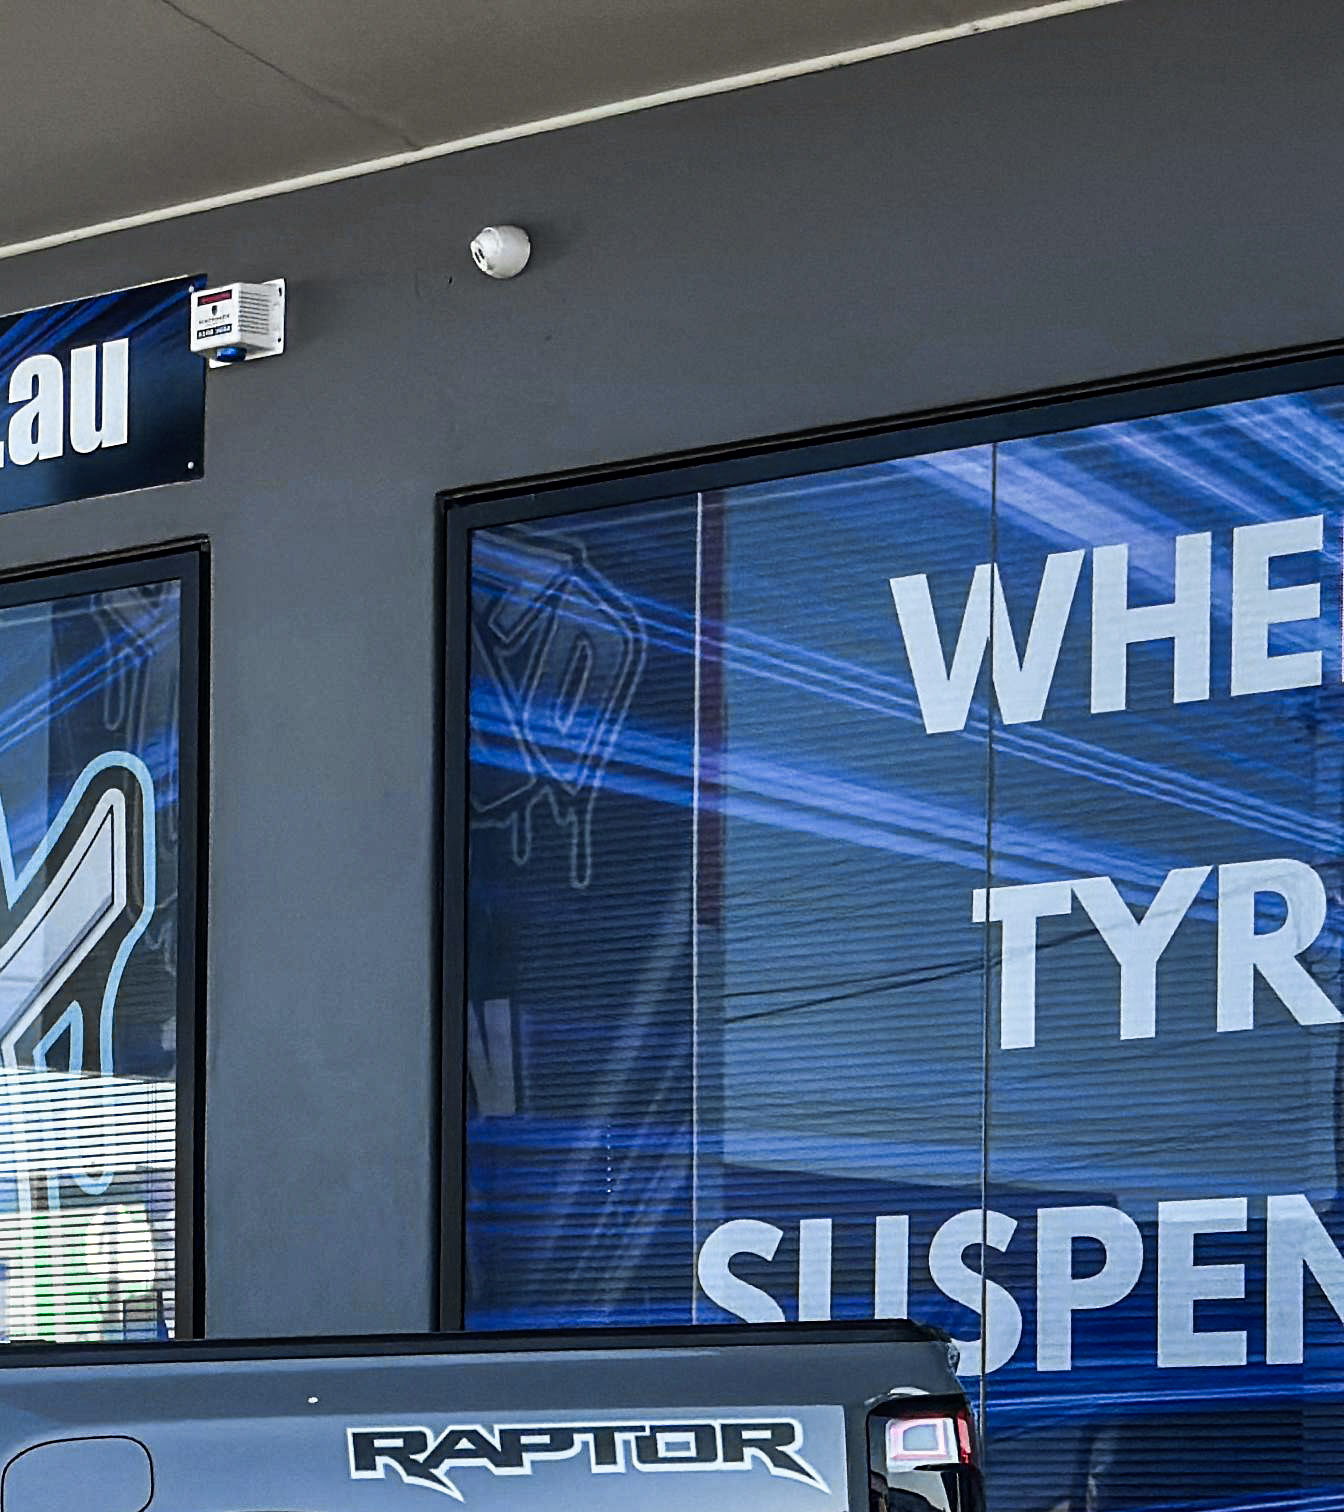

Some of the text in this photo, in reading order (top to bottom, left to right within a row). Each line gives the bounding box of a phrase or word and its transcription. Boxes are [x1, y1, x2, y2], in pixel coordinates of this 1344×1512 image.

[889, 513, 1344, 735] WHE
[971, 857, 1344, 1051] TYR
[697, 1193, 1344, 1378] SUSPEN
[346, 1416, 832, 1503] RAPTOR
